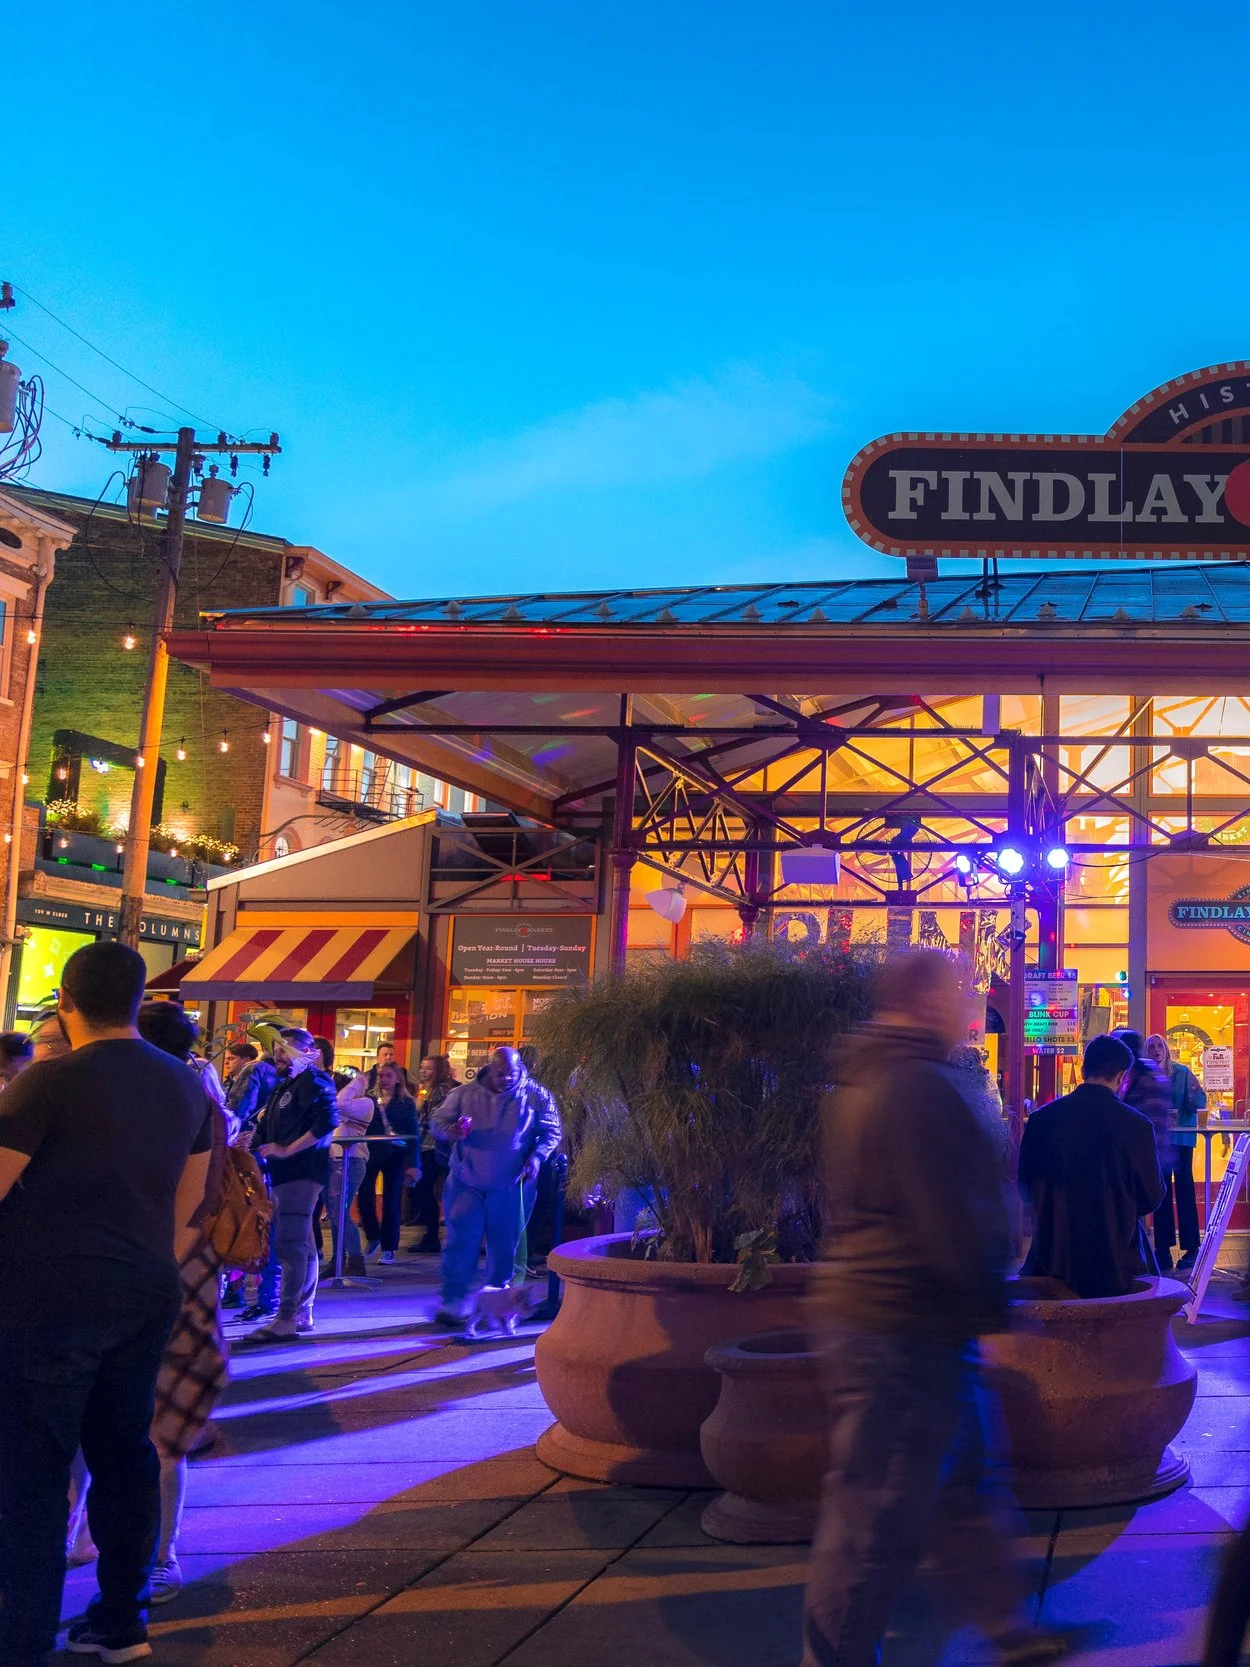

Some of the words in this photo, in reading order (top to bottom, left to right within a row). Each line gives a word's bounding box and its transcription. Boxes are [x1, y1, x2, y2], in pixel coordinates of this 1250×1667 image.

[887, 469, 1230, 523] FINDLAY
[84, 912, 115, 928] THE
[138, 920, 200, 941] OLUMNS
[526, 945, 587, 953] Tuesday-Sunday
